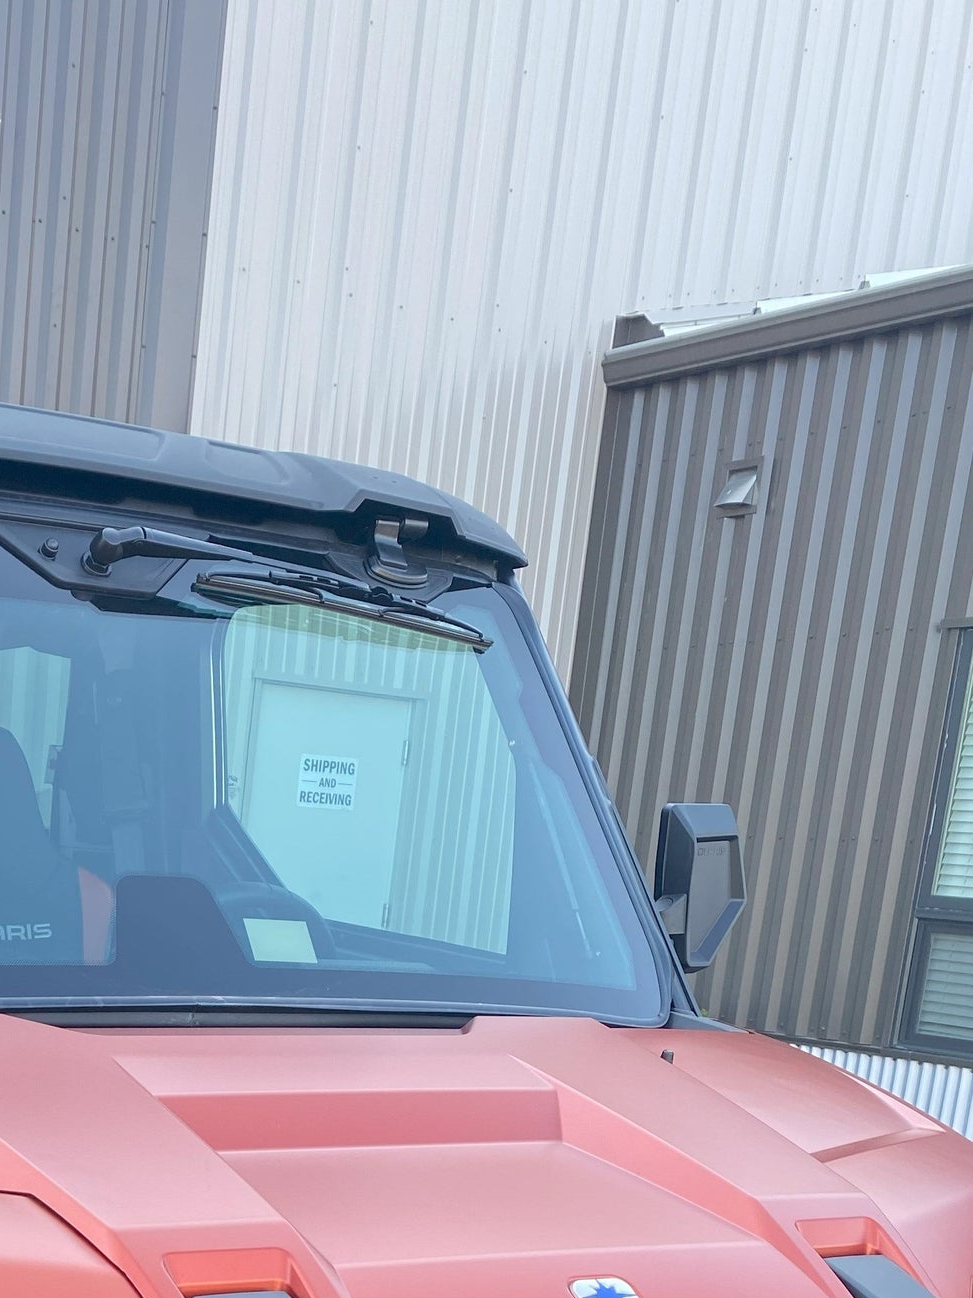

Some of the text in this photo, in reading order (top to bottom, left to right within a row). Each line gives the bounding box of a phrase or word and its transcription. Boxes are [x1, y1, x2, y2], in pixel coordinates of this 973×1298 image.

[303, 758, 355, 775] SHIPPING
[318, 777, 337, 788] AND
[299, 790, 352, 806] RECEIVING
